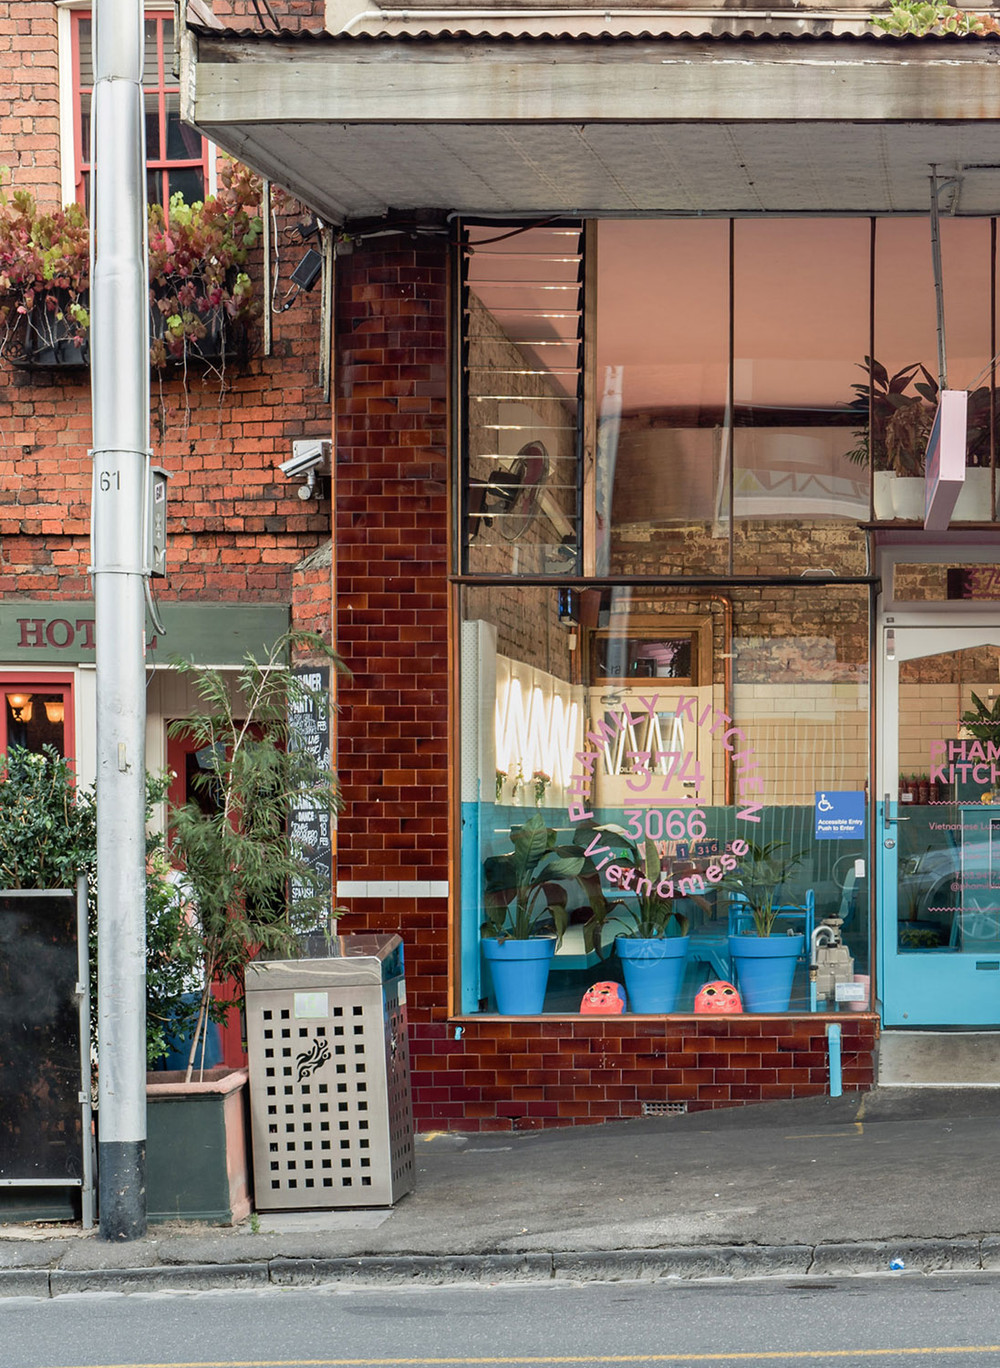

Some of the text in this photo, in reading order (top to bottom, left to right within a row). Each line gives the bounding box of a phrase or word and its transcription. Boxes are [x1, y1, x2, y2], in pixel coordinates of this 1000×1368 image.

[100, 470, 120, 492] 61
[567, 693, 764, 824] PHAMILY KITCHEN
[626, 751, 704, 792] 374
[623, 808, 707, 841] 3066
[848, 818, 863, 826] Entry
[929, 822, 978, 830] Vietnamese
[584, 833, 749, 898] Vietnamese
